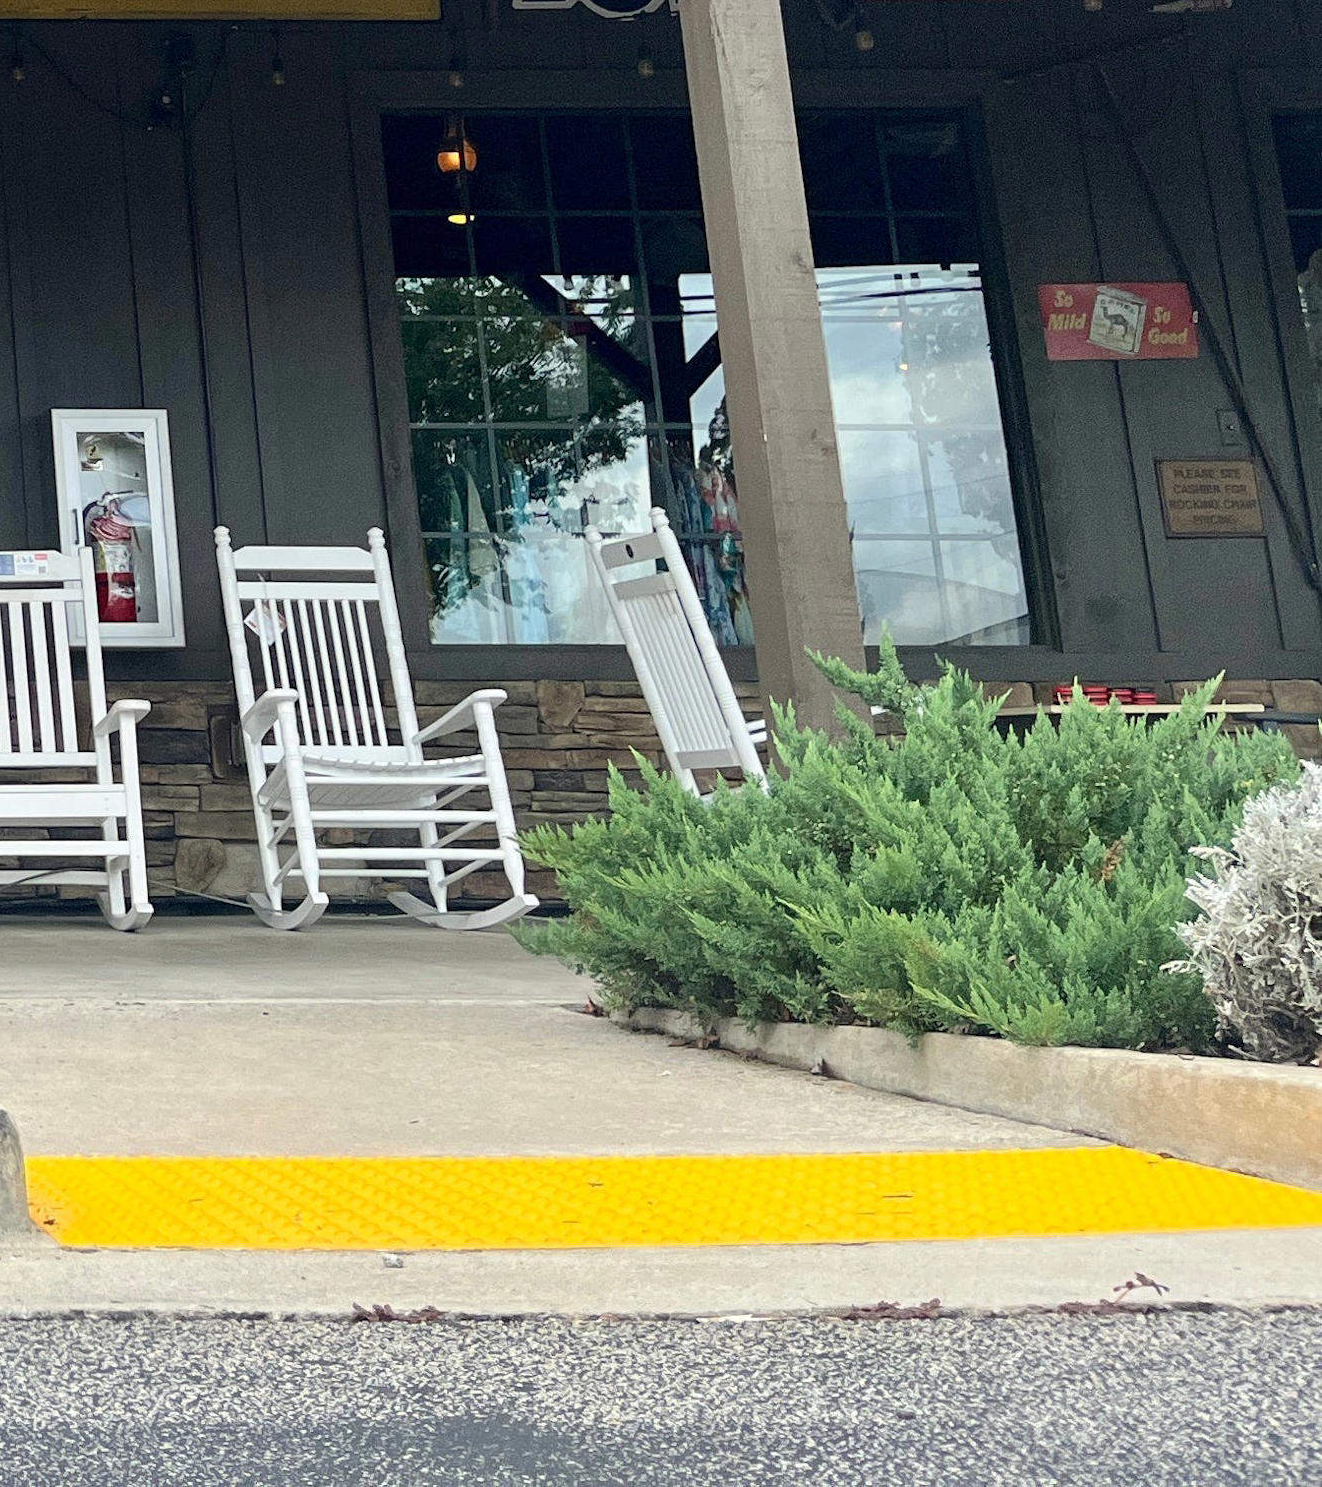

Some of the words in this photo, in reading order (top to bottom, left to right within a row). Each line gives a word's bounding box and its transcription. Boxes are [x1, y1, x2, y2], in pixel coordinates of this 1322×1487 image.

[1053, 289, 1074, 308] So
[1048, 313, 1087, 330] Mild
[1153, 306, 1171, 324] So
[1148, 327, 1189, 345] Good
